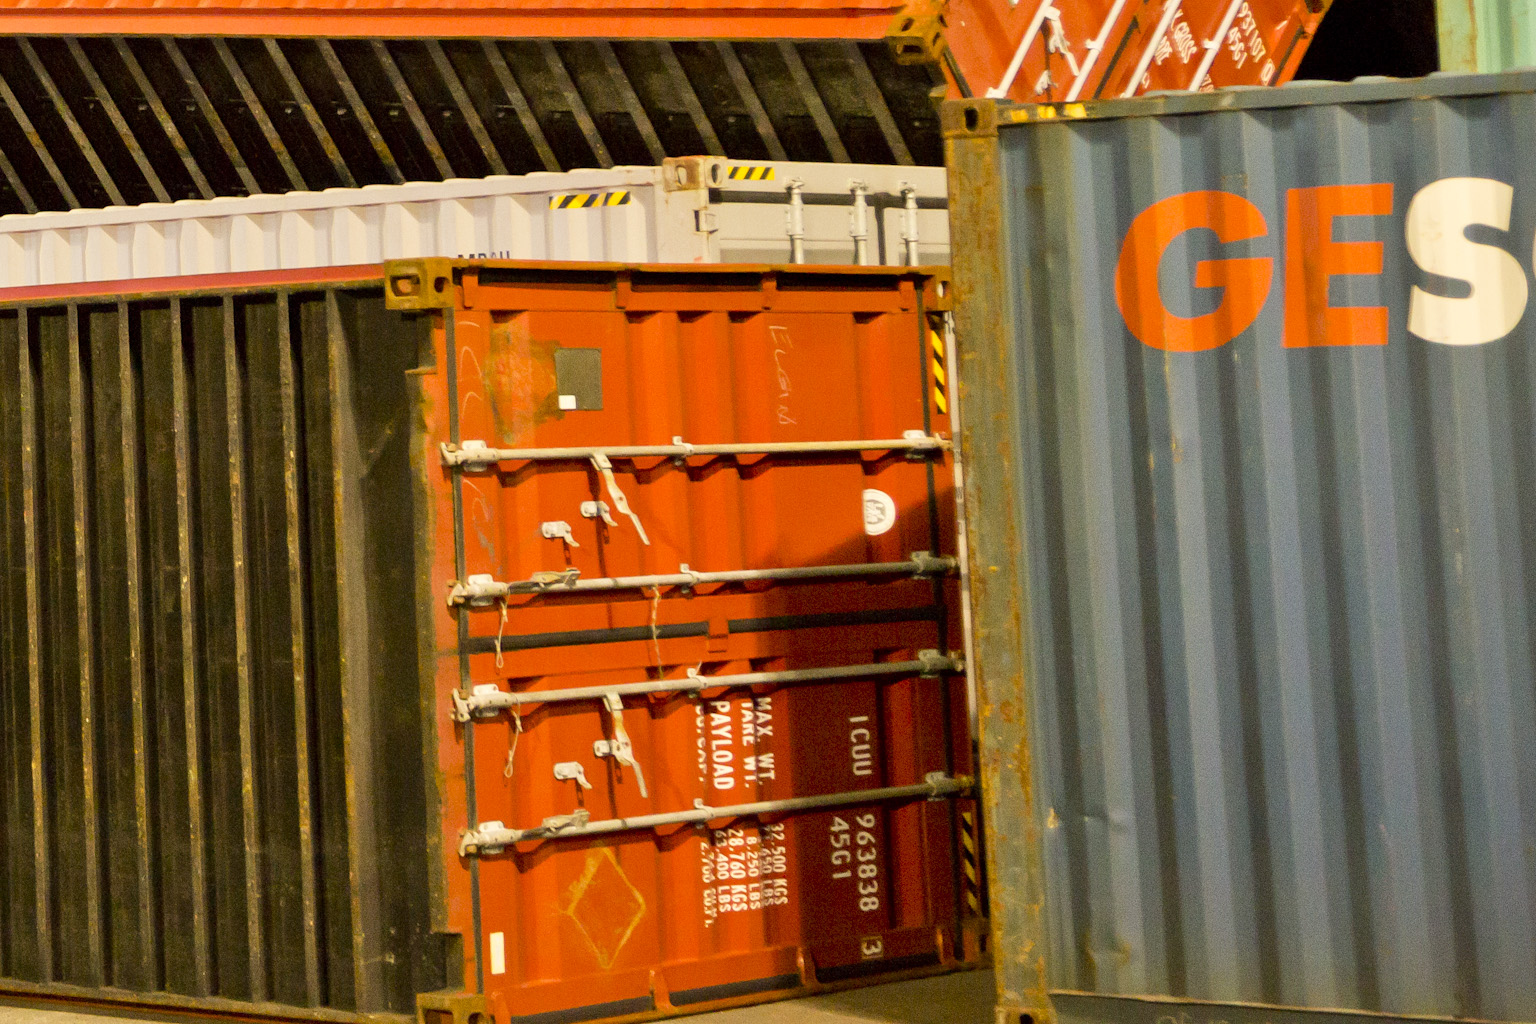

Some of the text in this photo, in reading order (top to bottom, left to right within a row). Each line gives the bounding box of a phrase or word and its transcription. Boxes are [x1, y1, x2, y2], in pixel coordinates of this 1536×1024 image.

[1228, 27, 1248, 70] 45G1
[1237, 2, 1267, 63] 937107
[711, 701, 735, 790] PAYLOAD
[755, 697, 776, 786] MAX. WT.
[849, 716, 880, 913] ICUU 963838
[728, 828, 748, 911] 28,760 KGS
[830, 816, 852, 879] 45G1
[718, 885, 731, 913] LBS
[749, 883, 761, 910] LBS
[773, 878, 789, 905] KGS
[864, 940, 882, 956] 3
